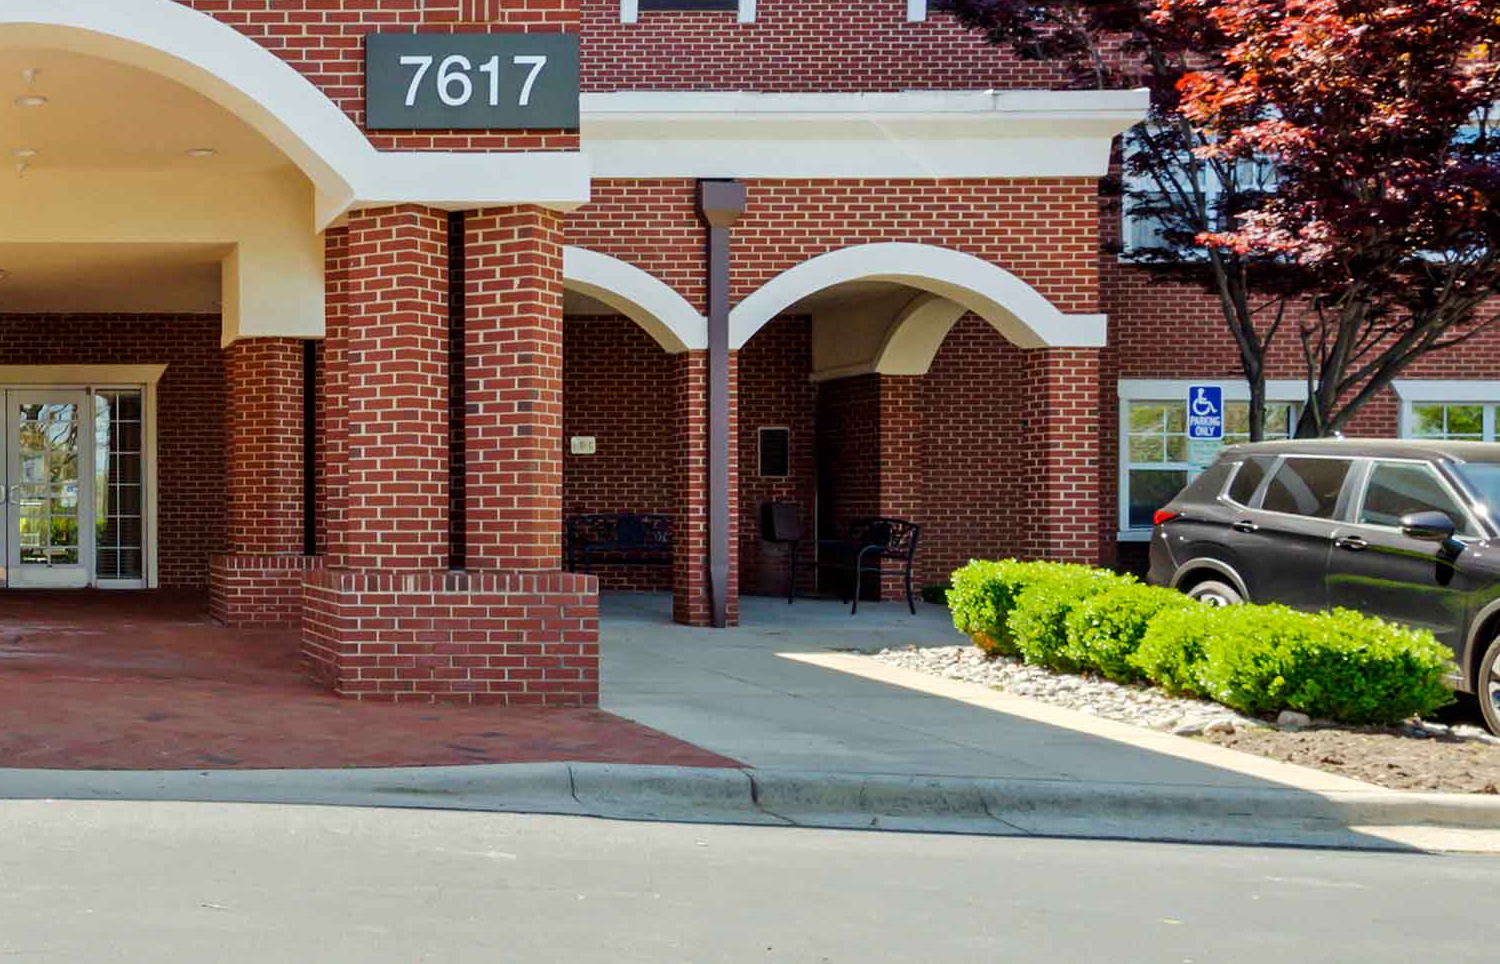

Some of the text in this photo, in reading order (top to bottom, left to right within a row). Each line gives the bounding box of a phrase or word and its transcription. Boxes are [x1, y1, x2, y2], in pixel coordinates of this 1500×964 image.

[399, 54, 547, 106] 7617
[1190, 416, 1221, 426] PARKING
[1195, 426, 1215, 436] ONLY
